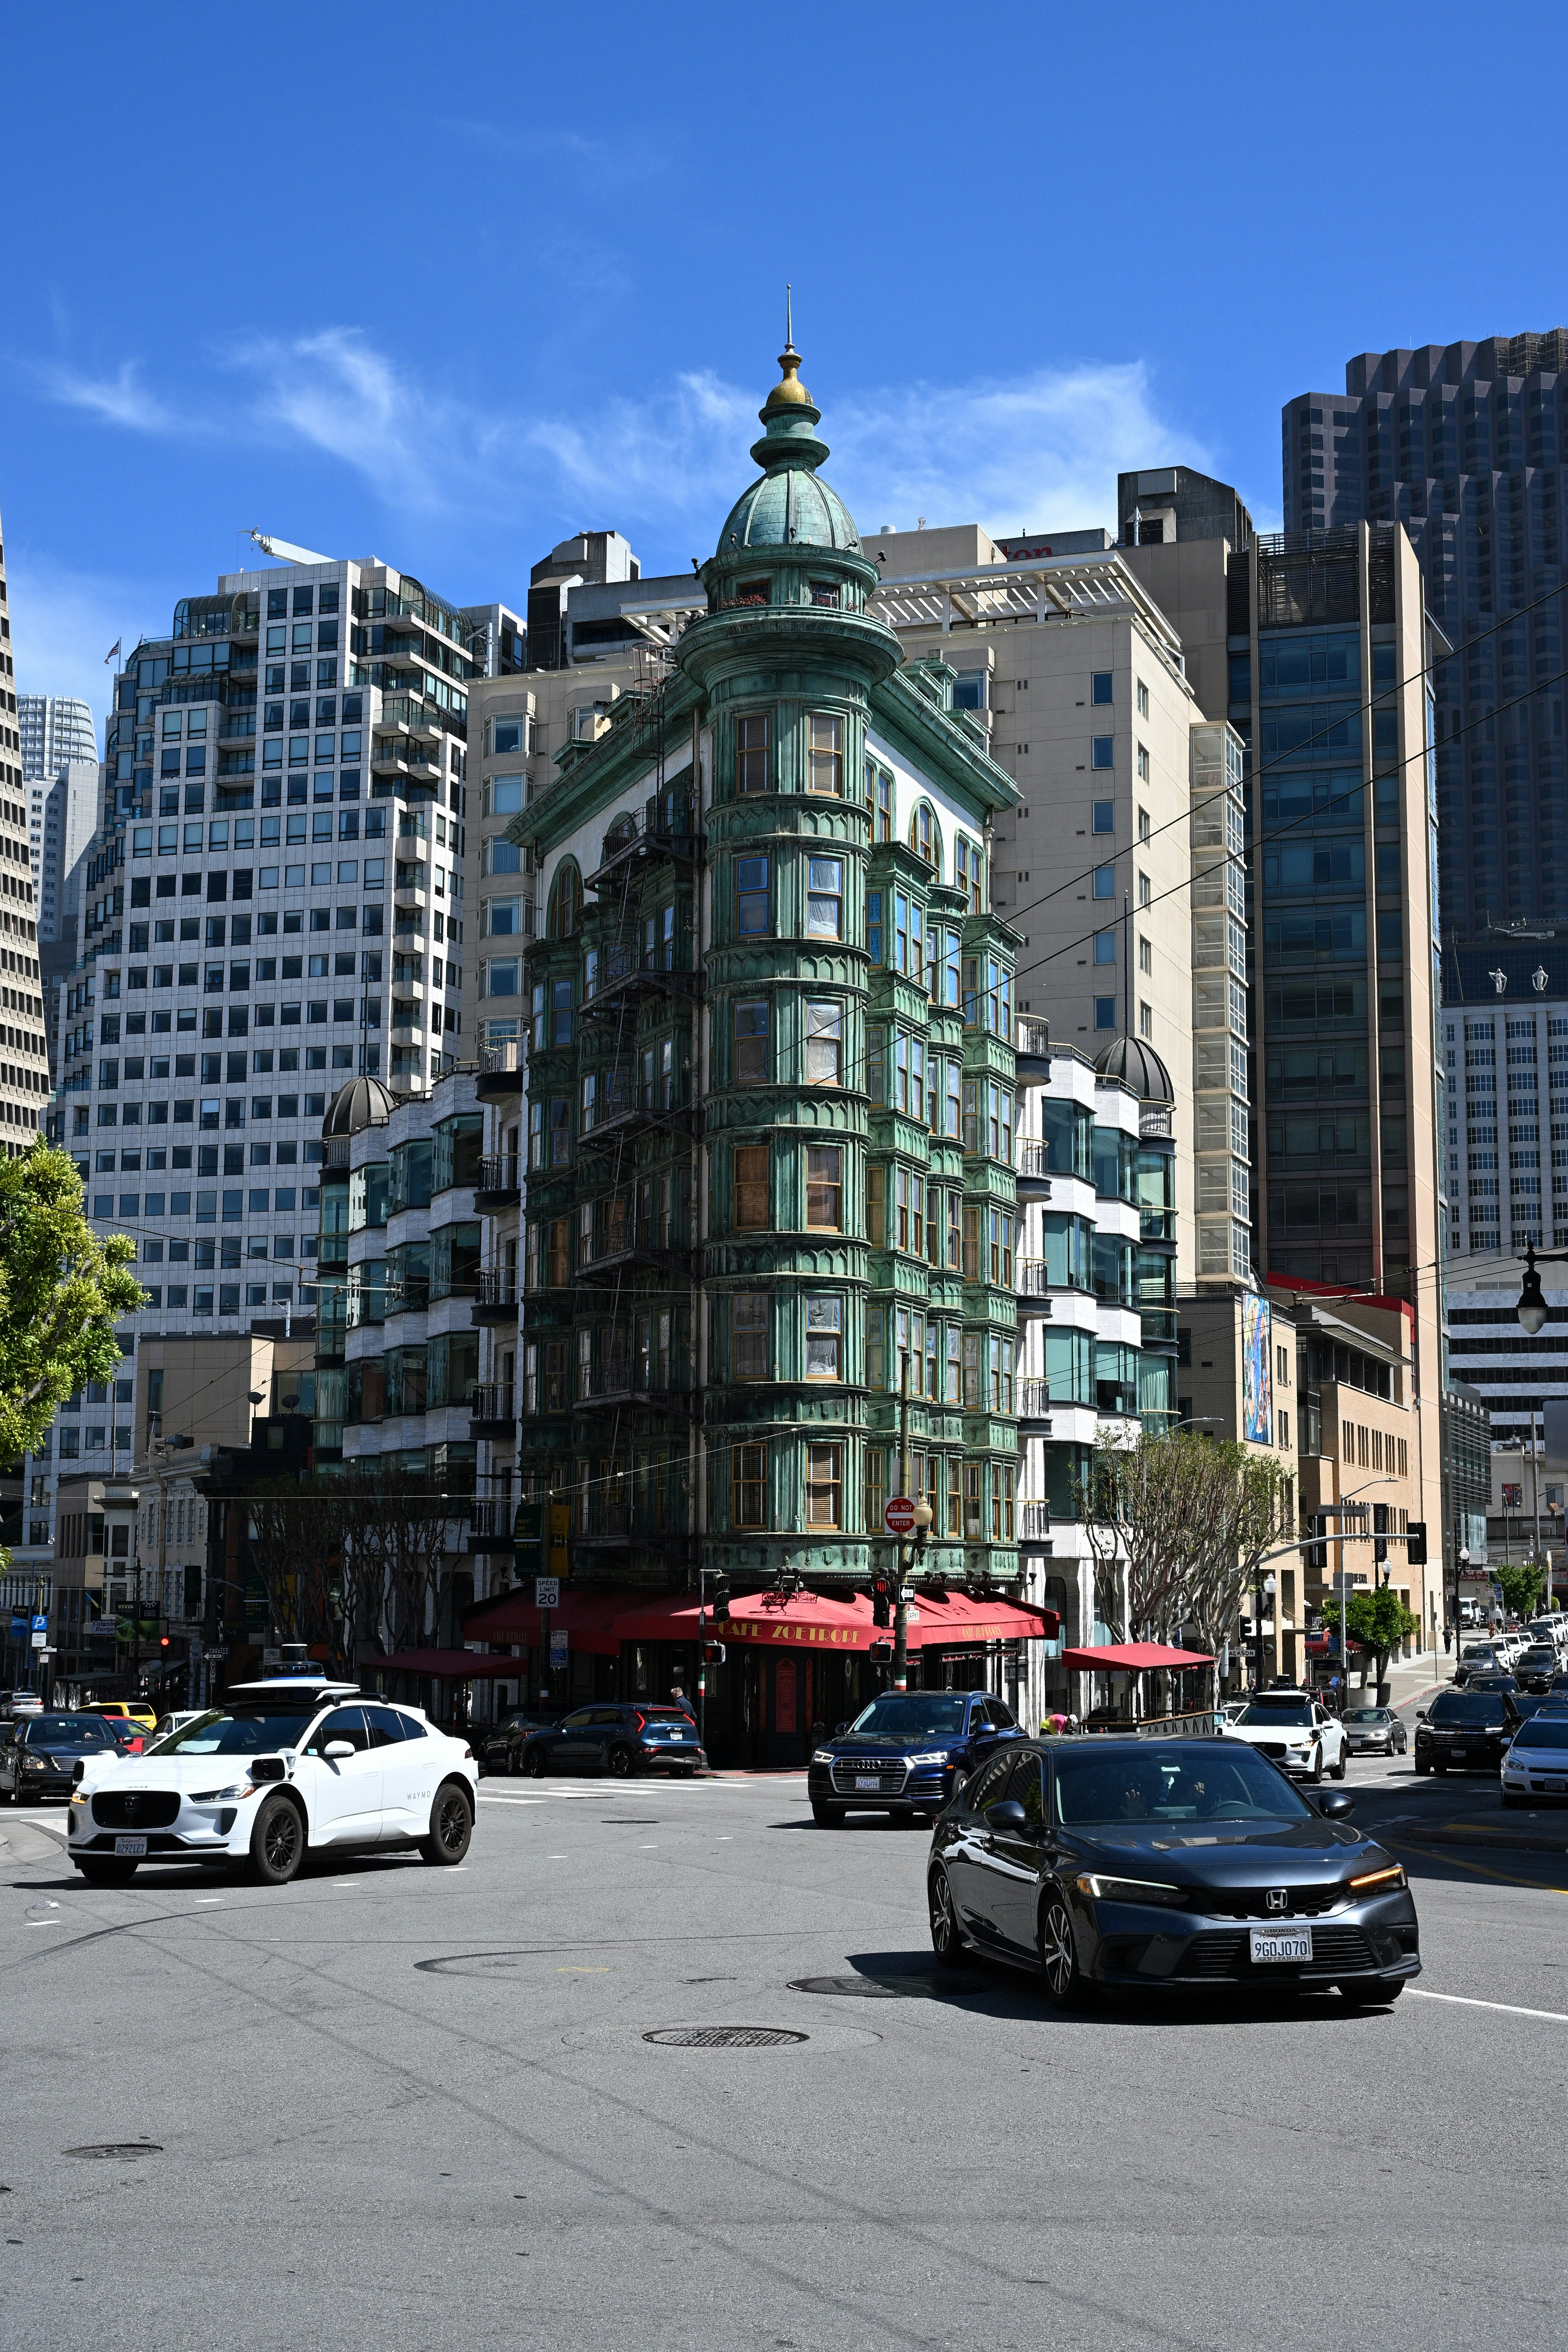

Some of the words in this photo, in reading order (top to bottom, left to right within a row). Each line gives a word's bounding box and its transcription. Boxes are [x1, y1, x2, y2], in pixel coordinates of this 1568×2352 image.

[538, 1593, 556, 1604] 20
[719, 1622, 762, 1637] CAFE
[772, 1625, 860, 1643] ZOETROPE
[407, 1790, 430, 1800] WAYMO
